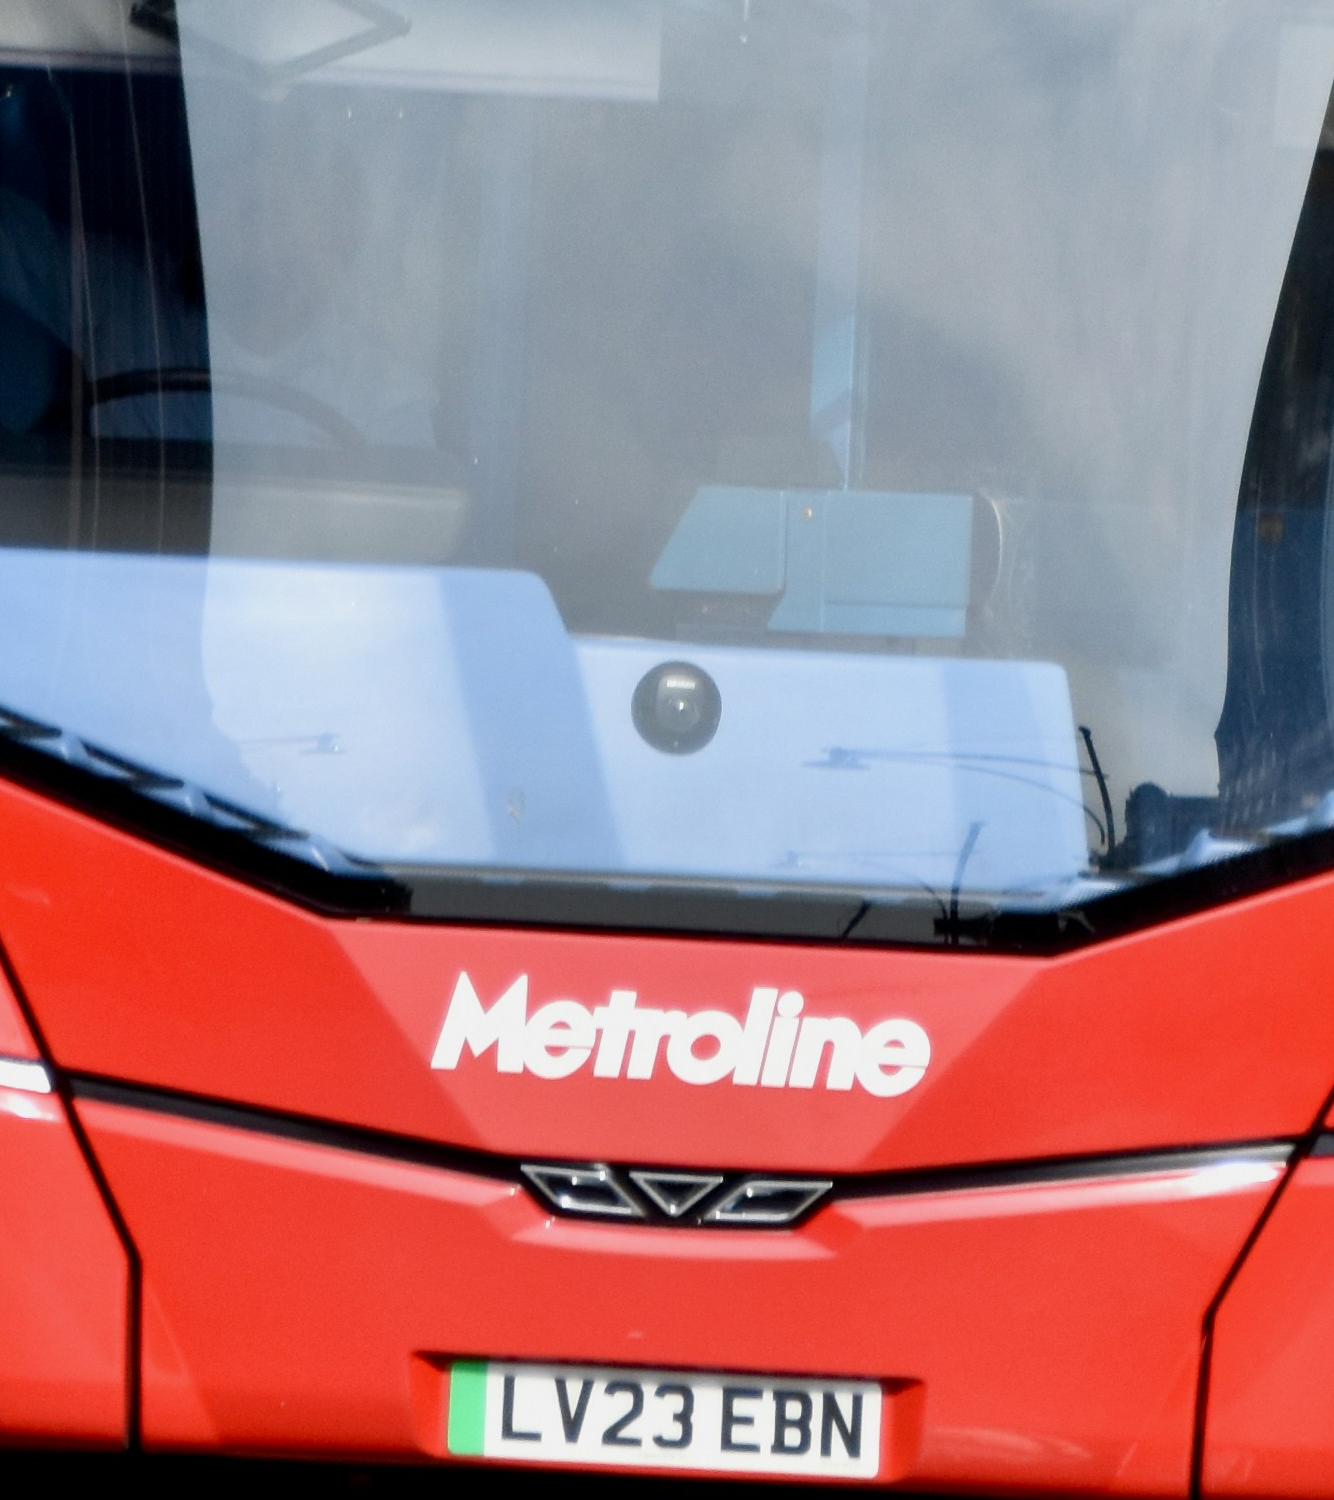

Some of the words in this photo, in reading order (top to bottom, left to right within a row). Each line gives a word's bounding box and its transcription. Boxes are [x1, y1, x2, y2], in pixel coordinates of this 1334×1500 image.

[429, 970, 932, 1098] Metroline
[500, 1373, 696, 1451] LV23
[719, 1384, 865, 1461] EBN
